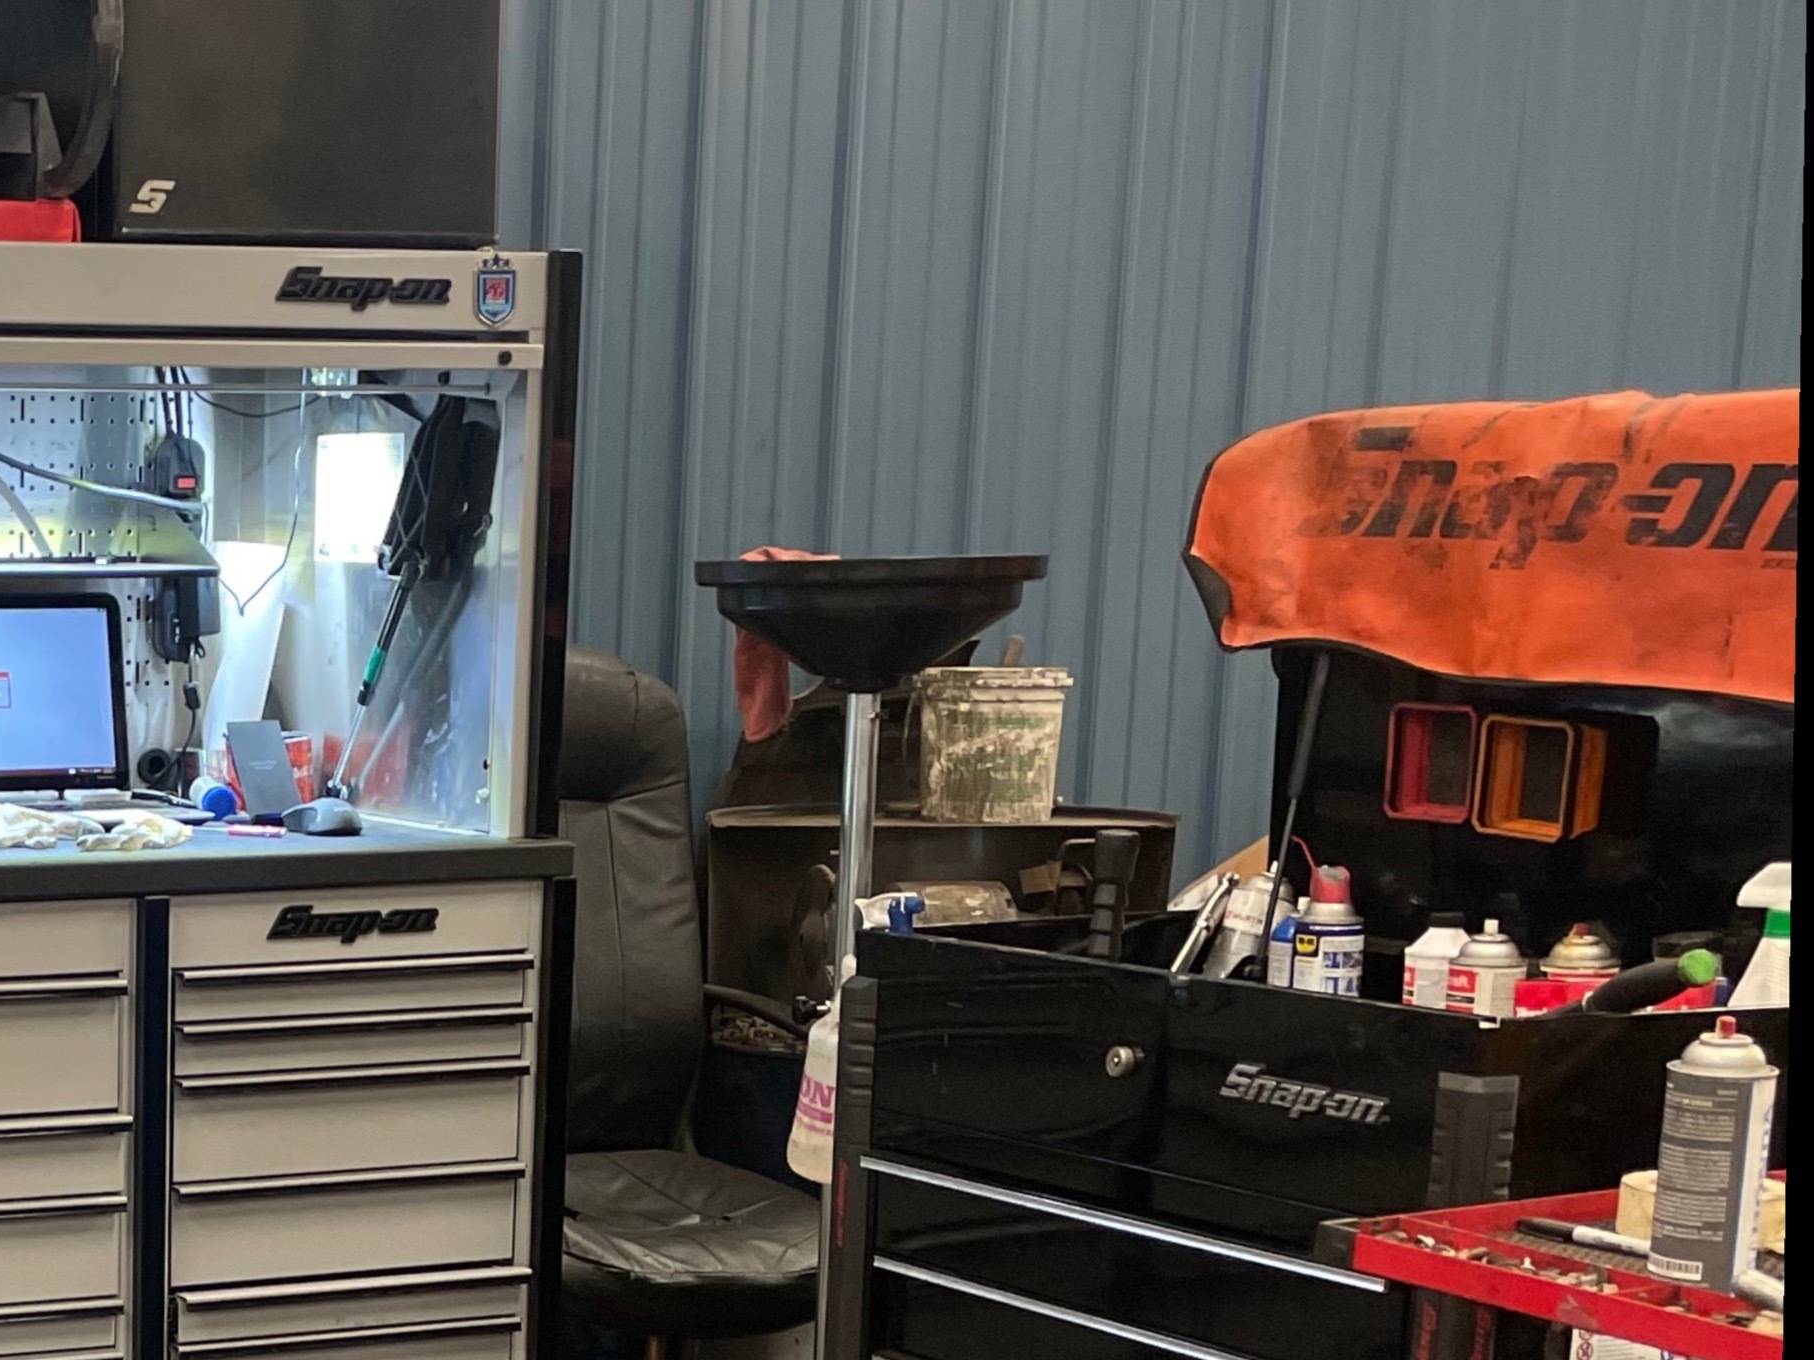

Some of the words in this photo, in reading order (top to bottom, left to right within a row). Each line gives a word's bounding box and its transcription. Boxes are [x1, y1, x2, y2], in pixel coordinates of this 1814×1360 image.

[275, 266, 452, 312] Snap-on
[266, 904, 440, 945] Snap-on
[1219, 1063, 1386, 1124] Snap-on
